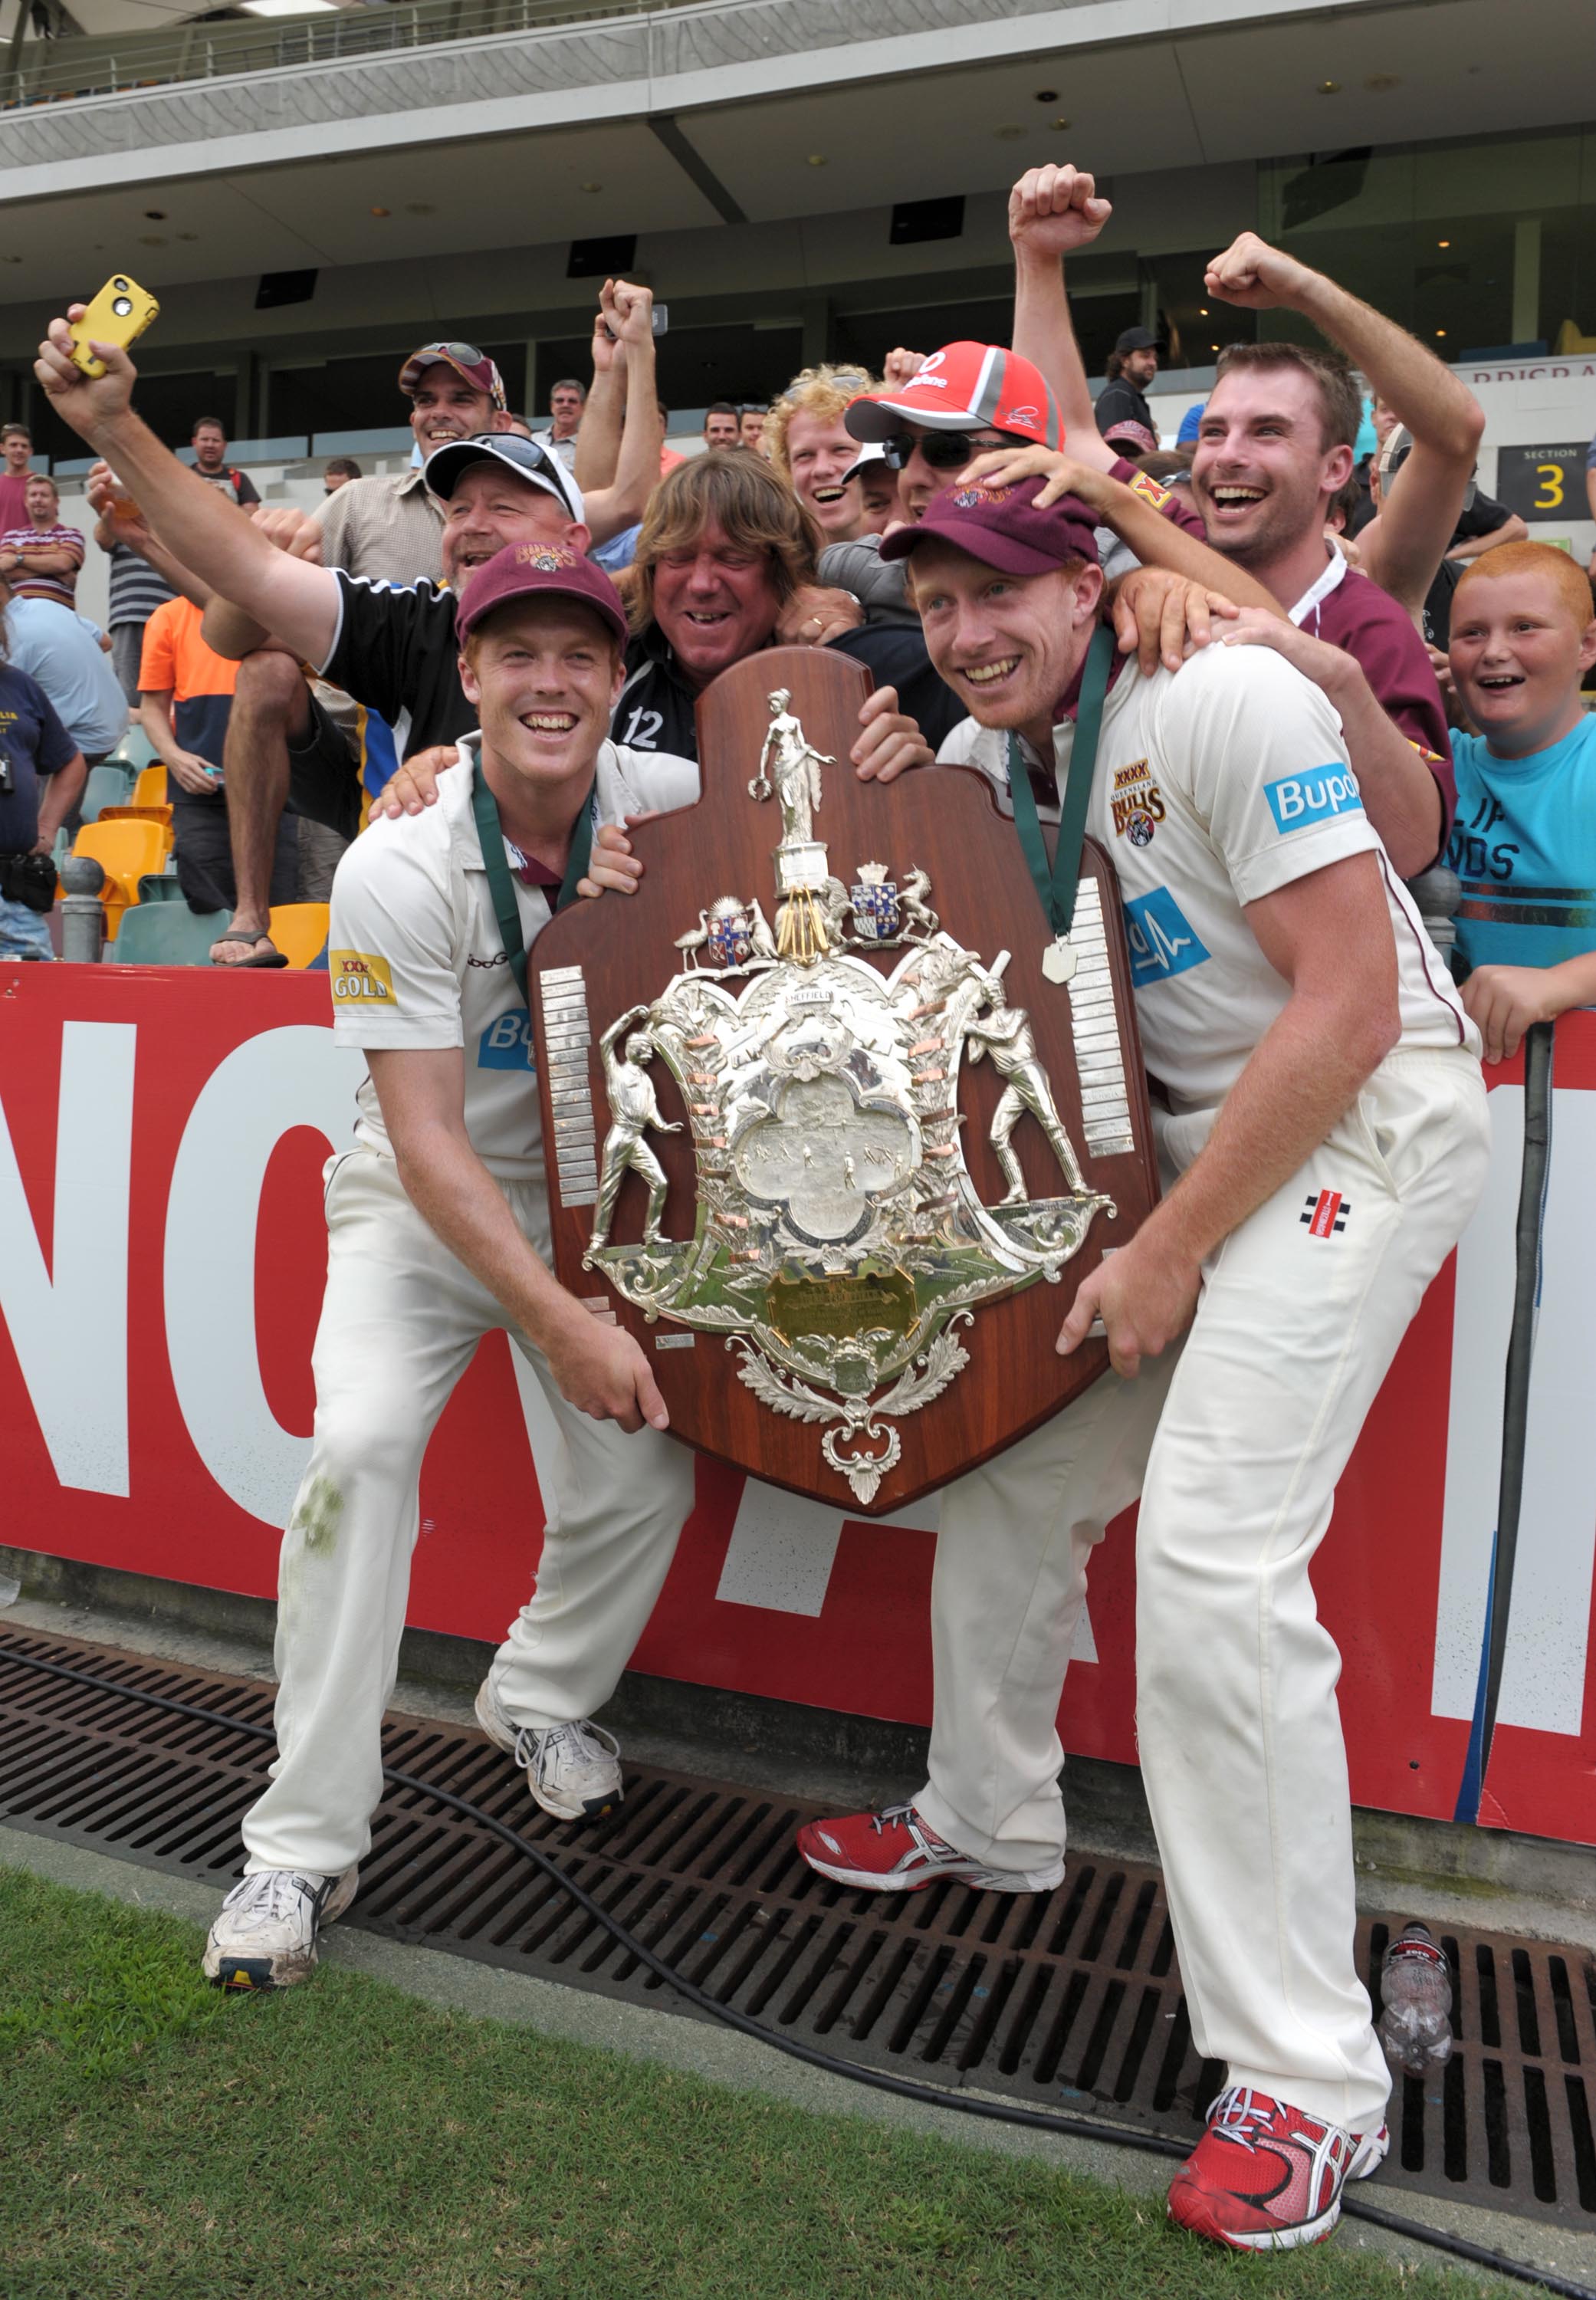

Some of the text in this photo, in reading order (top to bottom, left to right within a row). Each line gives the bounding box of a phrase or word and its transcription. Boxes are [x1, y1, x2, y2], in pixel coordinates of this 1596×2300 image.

[1524, 449, 1578, 460] SECTION
[1534, 464, 1565, 508] 3
[622, 705, 664, 749] 12
[1115, 761, 1148, 786] XXXX
[1110, 779, 1157, 802] QUEENSLAND
